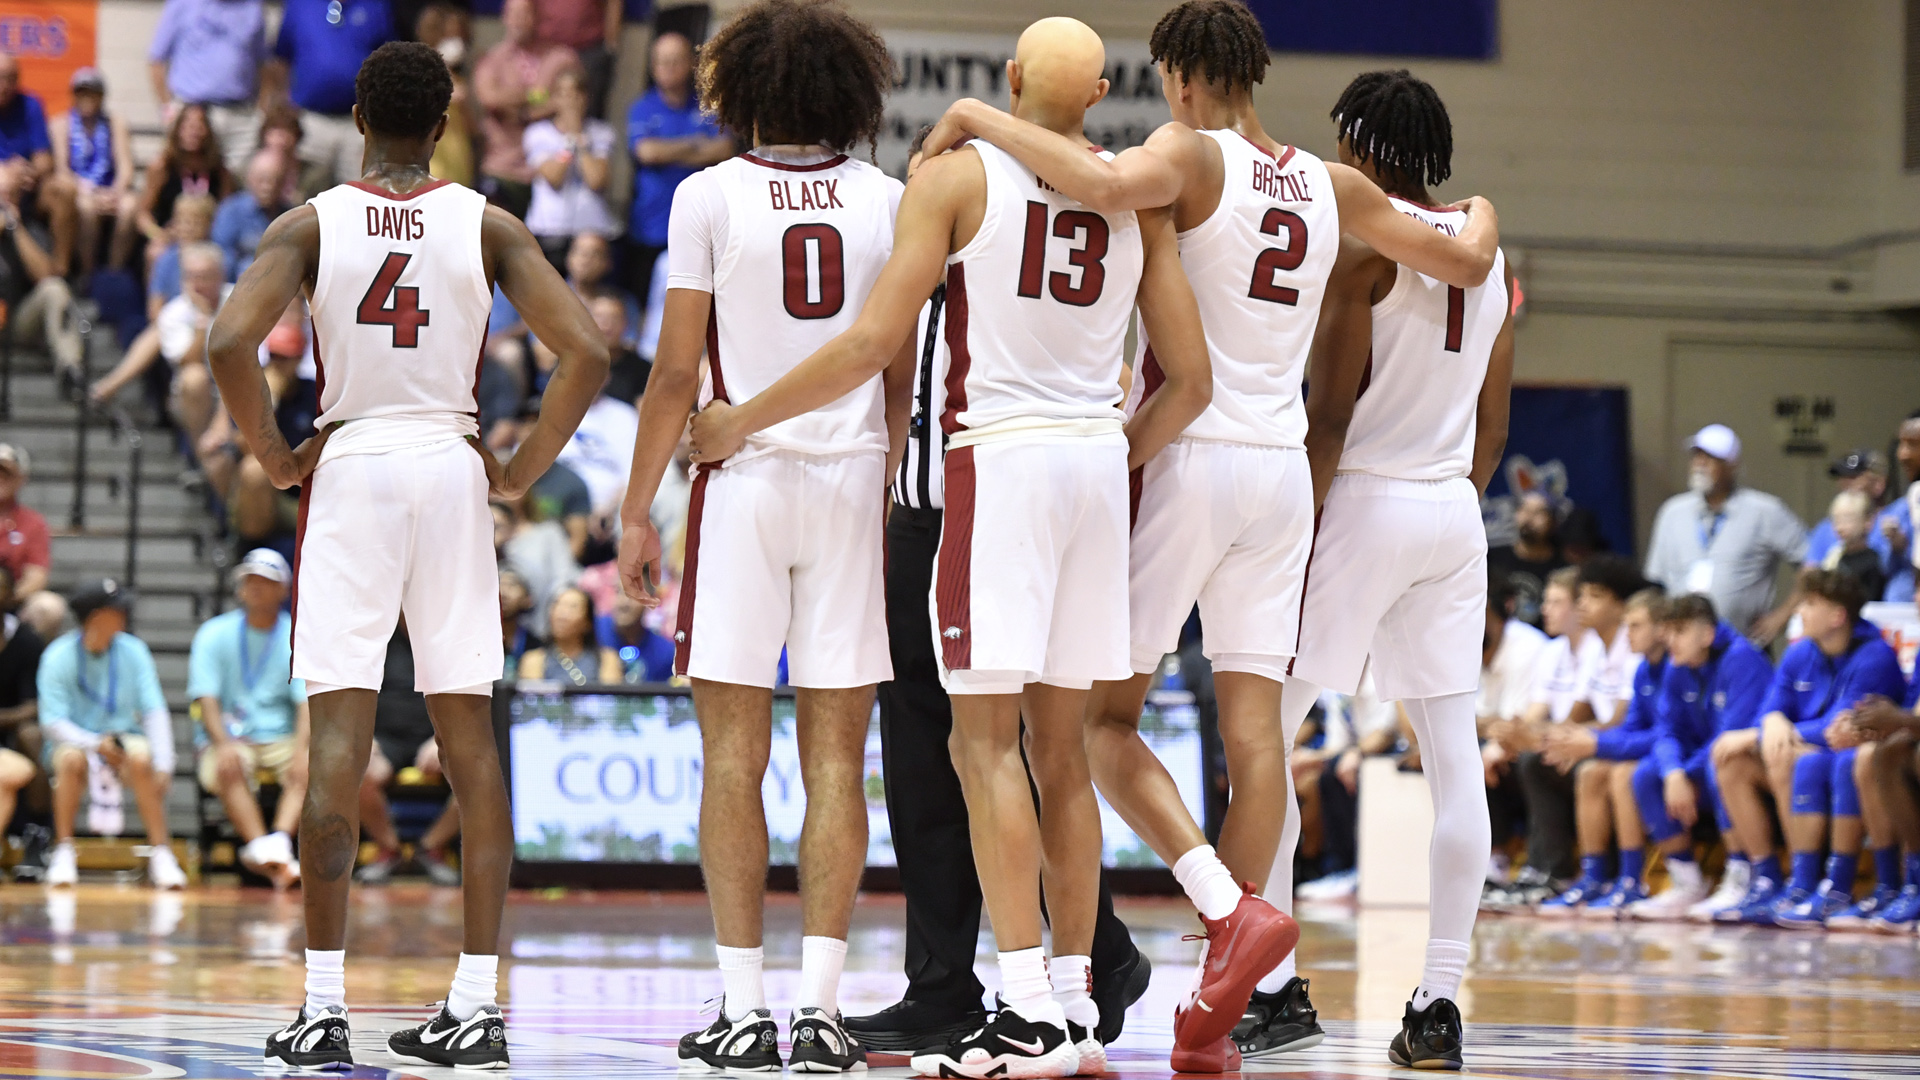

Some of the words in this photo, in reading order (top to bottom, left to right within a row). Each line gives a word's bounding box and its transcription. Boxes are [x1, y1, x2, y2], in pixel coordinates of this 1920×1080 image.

[0, 14, 69, 57] ERS
[890, 54, 1009, 94] UNTY
[366, 205, 425, 242] DAVIS
[768, 178, 844, 211] BLACK
[781, 222, 845, 320] 0
[1016, 199, 1110, 307] 13
[1247, 207, 1309, 307] 2
[356, 251, 430, 349] 4
[1443, 284, 1465, 354] 1
[556, 753, 800, 806] COUY
